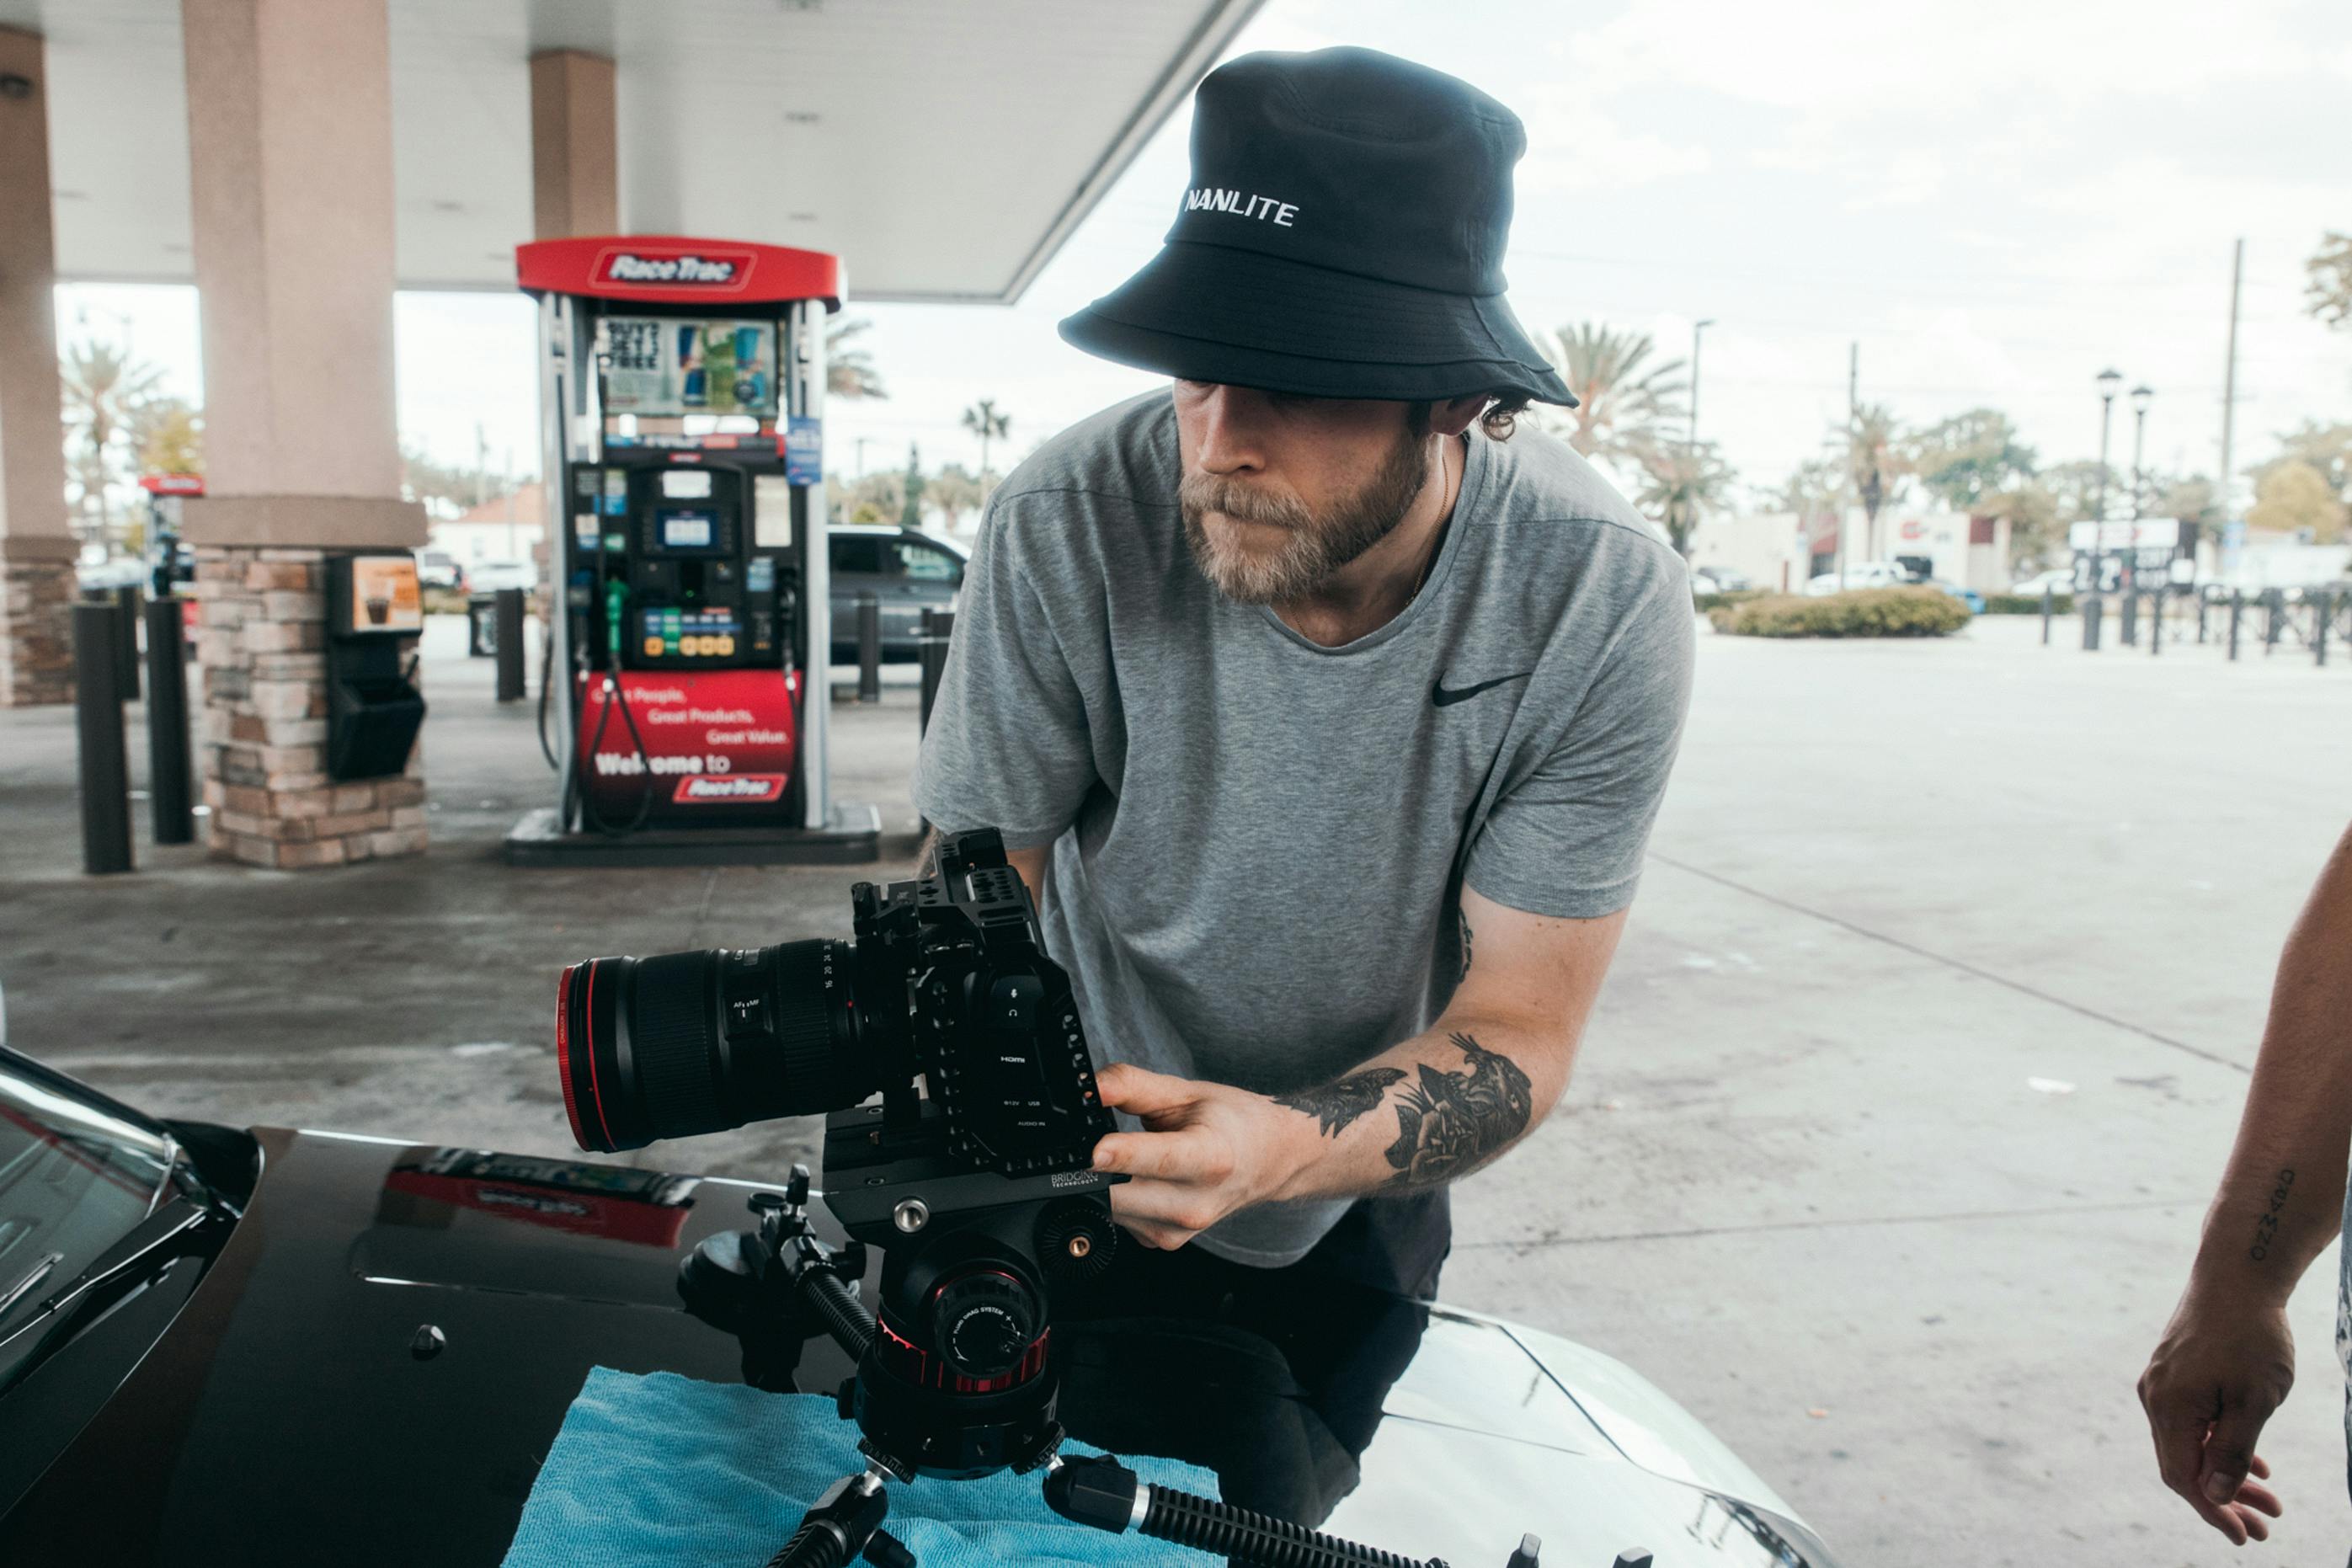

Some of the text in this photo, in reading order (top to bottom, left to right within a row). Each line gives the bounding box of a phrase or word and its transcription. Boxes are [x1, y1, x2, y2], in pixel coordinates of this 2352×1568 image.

[1184, 188, 1300, 227] NANLITE
[609, 253, 734, 282] RaceTrac
[647, 708, 687, 724] Great
[706, 728, 745, 745] Great
[595, 750, 731, 776] Welome to
[824, 965, 833, 975] 20
[824, 979, 834, 989] 16
[733, 998, 760, 1009] AF MF
